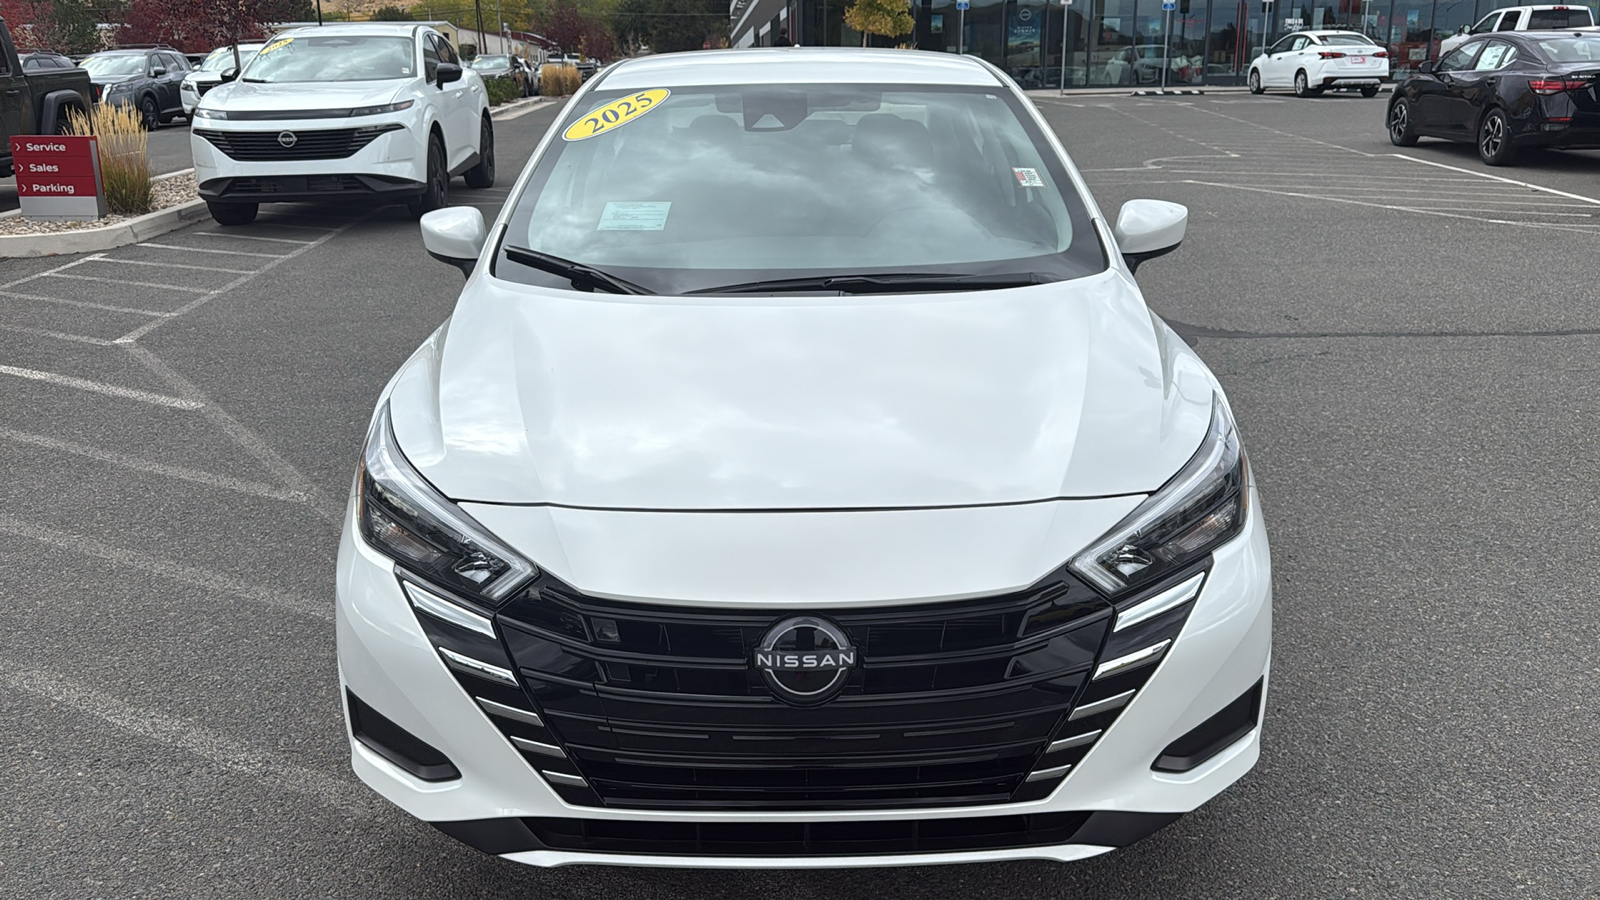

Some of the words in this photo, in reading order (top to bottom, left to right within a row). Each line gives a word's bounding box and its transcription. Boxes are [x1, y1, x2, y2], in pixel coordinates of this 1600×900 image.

[584, 93, 653, 133] 2025
[26, 142, 66, 151] Service
[29, 163, 59, 172] Sales
[32, 183, 75, 194] Parking
[757, 652, 854, 668] NISSAN
